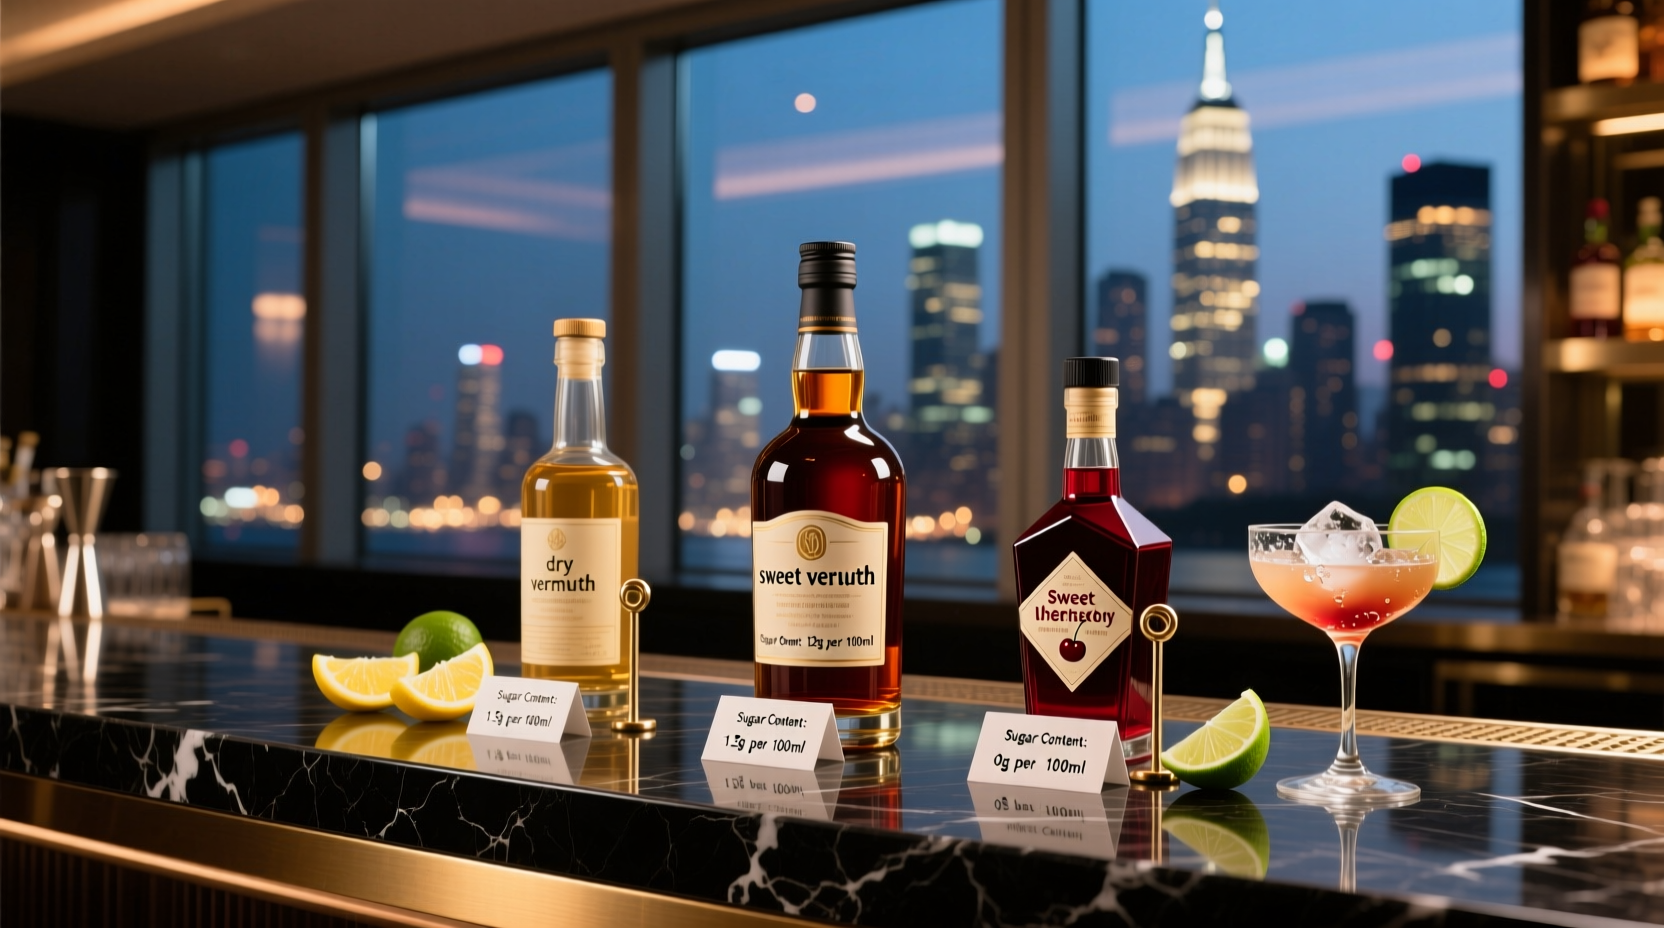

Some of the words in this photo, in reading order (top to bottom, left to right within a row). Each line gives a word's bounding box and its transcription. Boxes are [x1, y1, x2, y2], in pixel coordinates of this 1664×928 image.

[546, 555, 574, 576] dry
[530, 573, 596, 592] vermuth
[759, 567, 802, 586] sweet
[1048, 589, 1096, 606] Sweet
[846, 634, 874, 647] 100ml
[505, 715, 523, 728] per
[736, 711, 767, 727] Sugar
[1004, 729, 1039, 746] Sugar
[748, 739, 768, 754] per
[773, 739, 807, 754] 100ml
[993, 753, 1011, 772] 0g
[1013, 758, 1037, 773] per
[1046, 757, 1087, 775] 100ml
